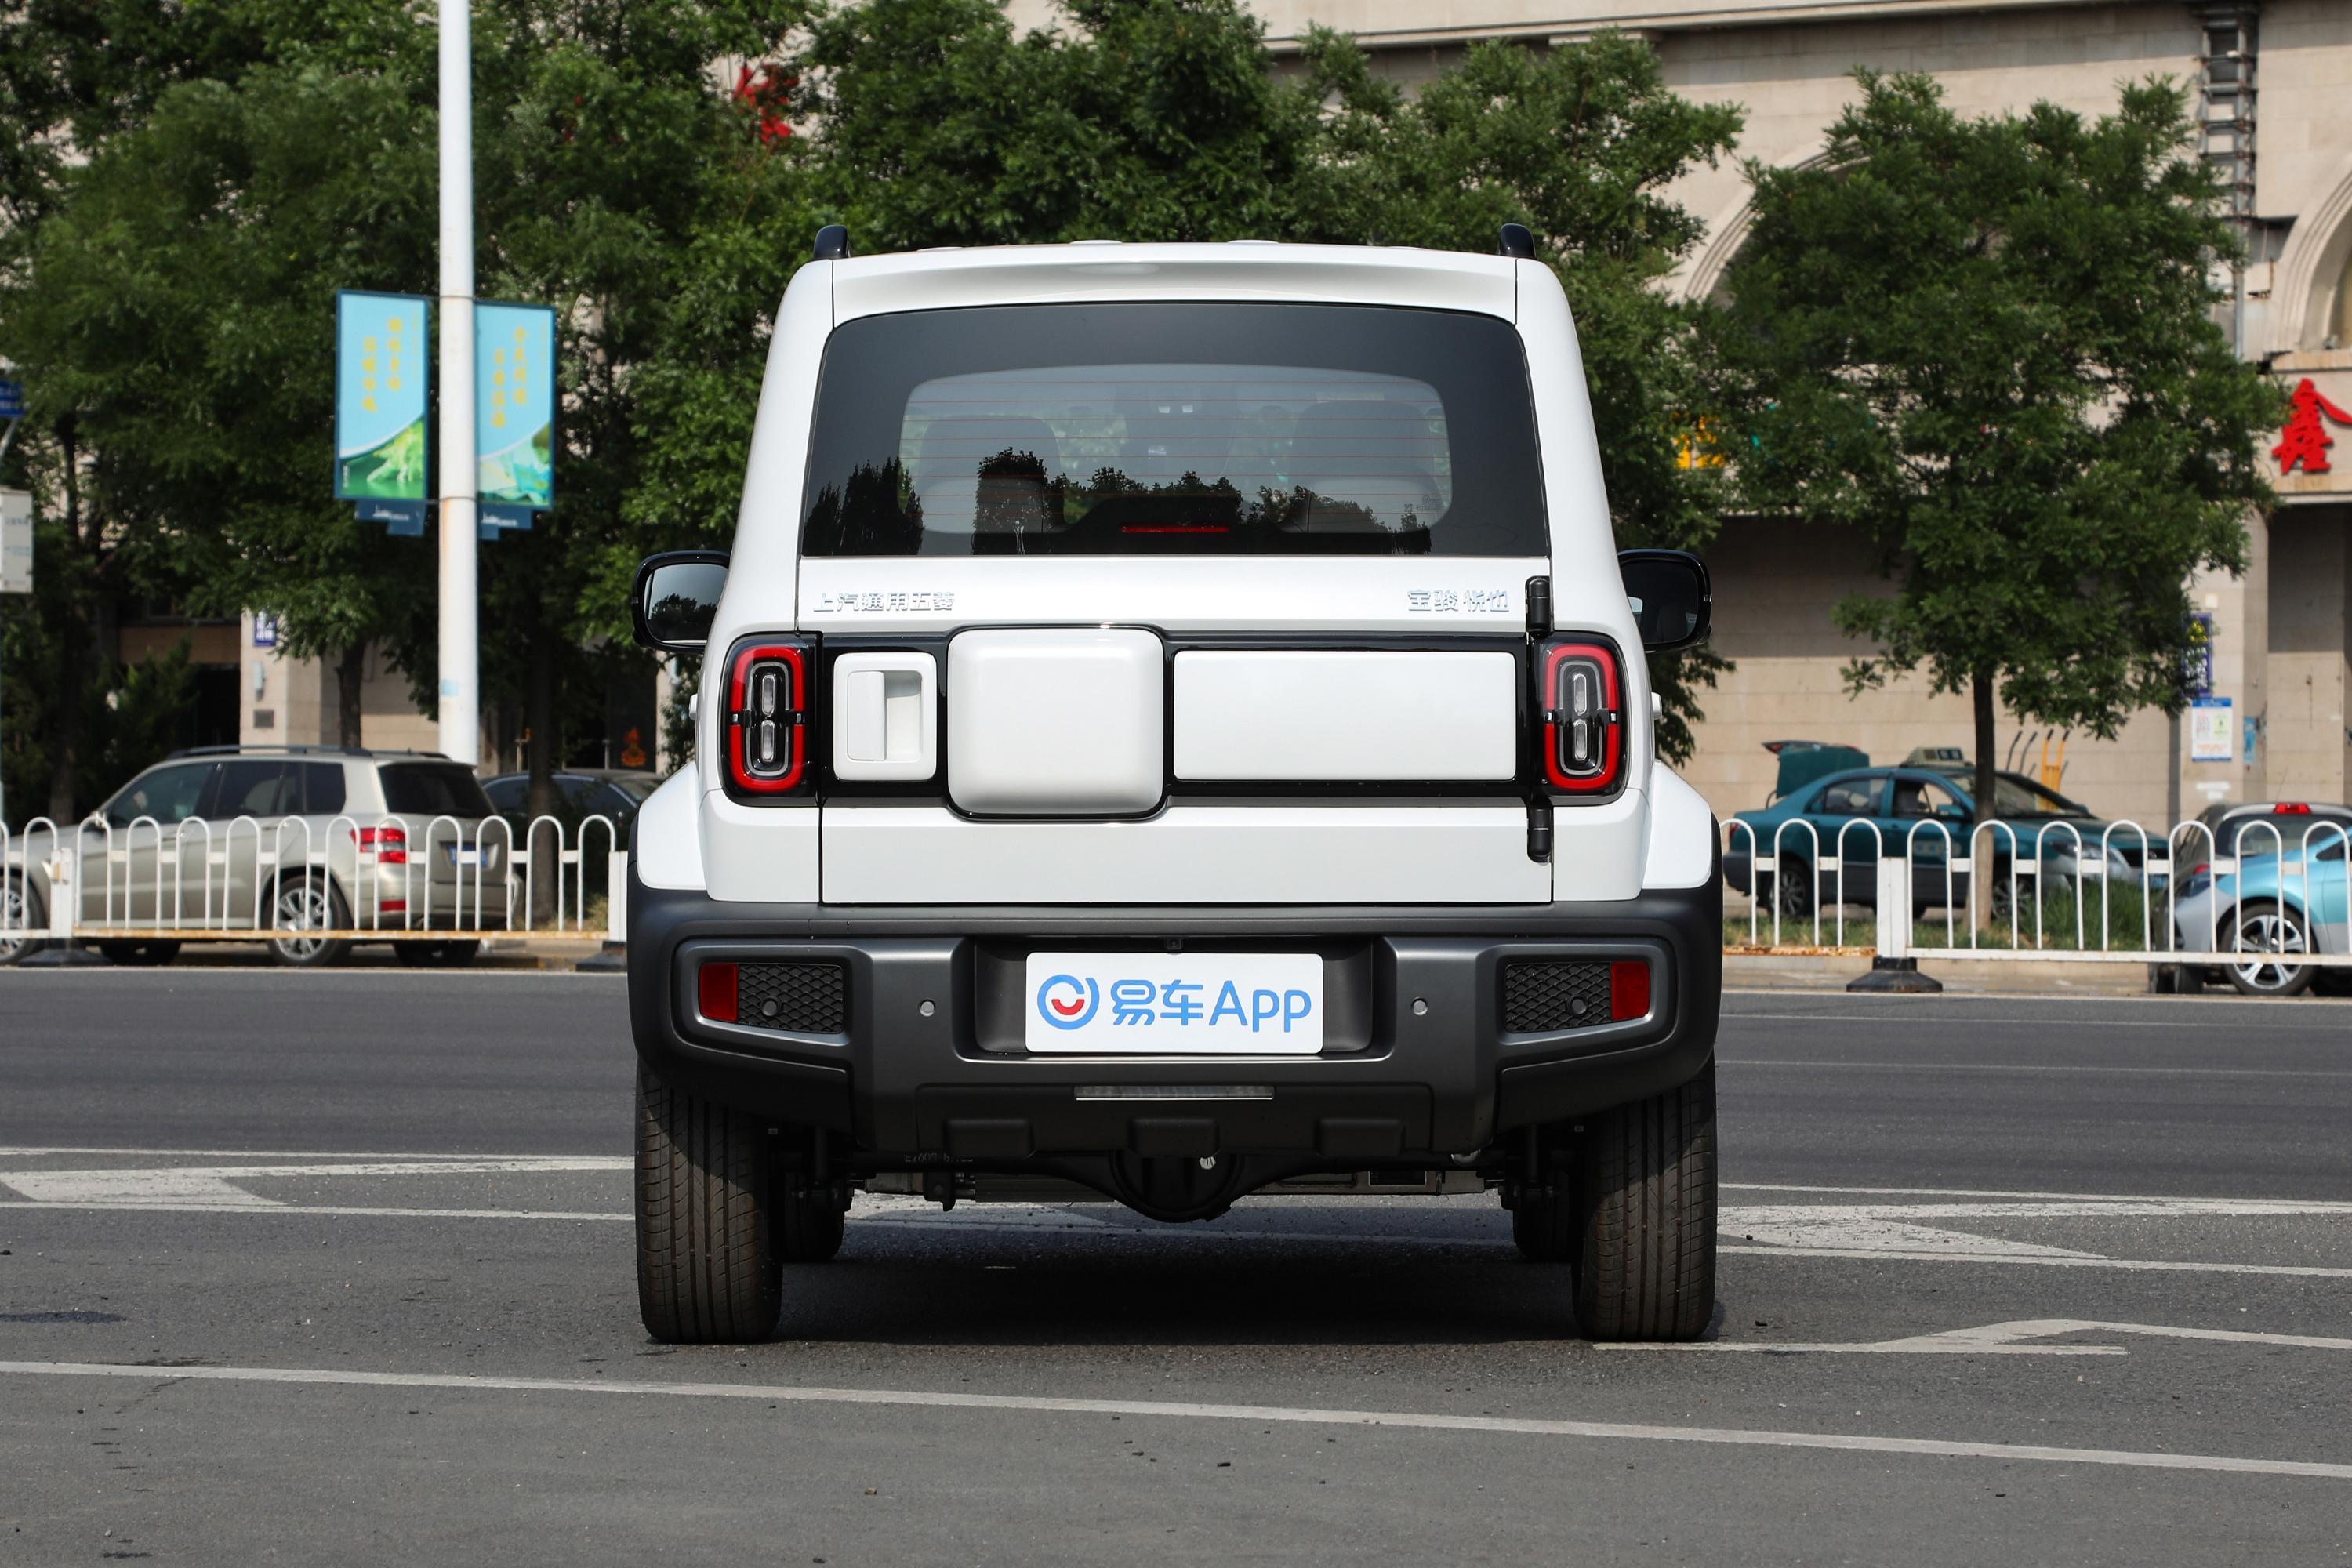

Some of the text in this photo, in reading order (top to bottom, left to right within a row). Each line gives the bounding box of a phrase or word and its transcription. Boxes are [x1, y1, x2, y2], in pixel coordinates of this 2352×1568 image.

[813, 592, 955, 612] 上汽通用五菱
[1109, 979, 1312, 1033] 易车App
